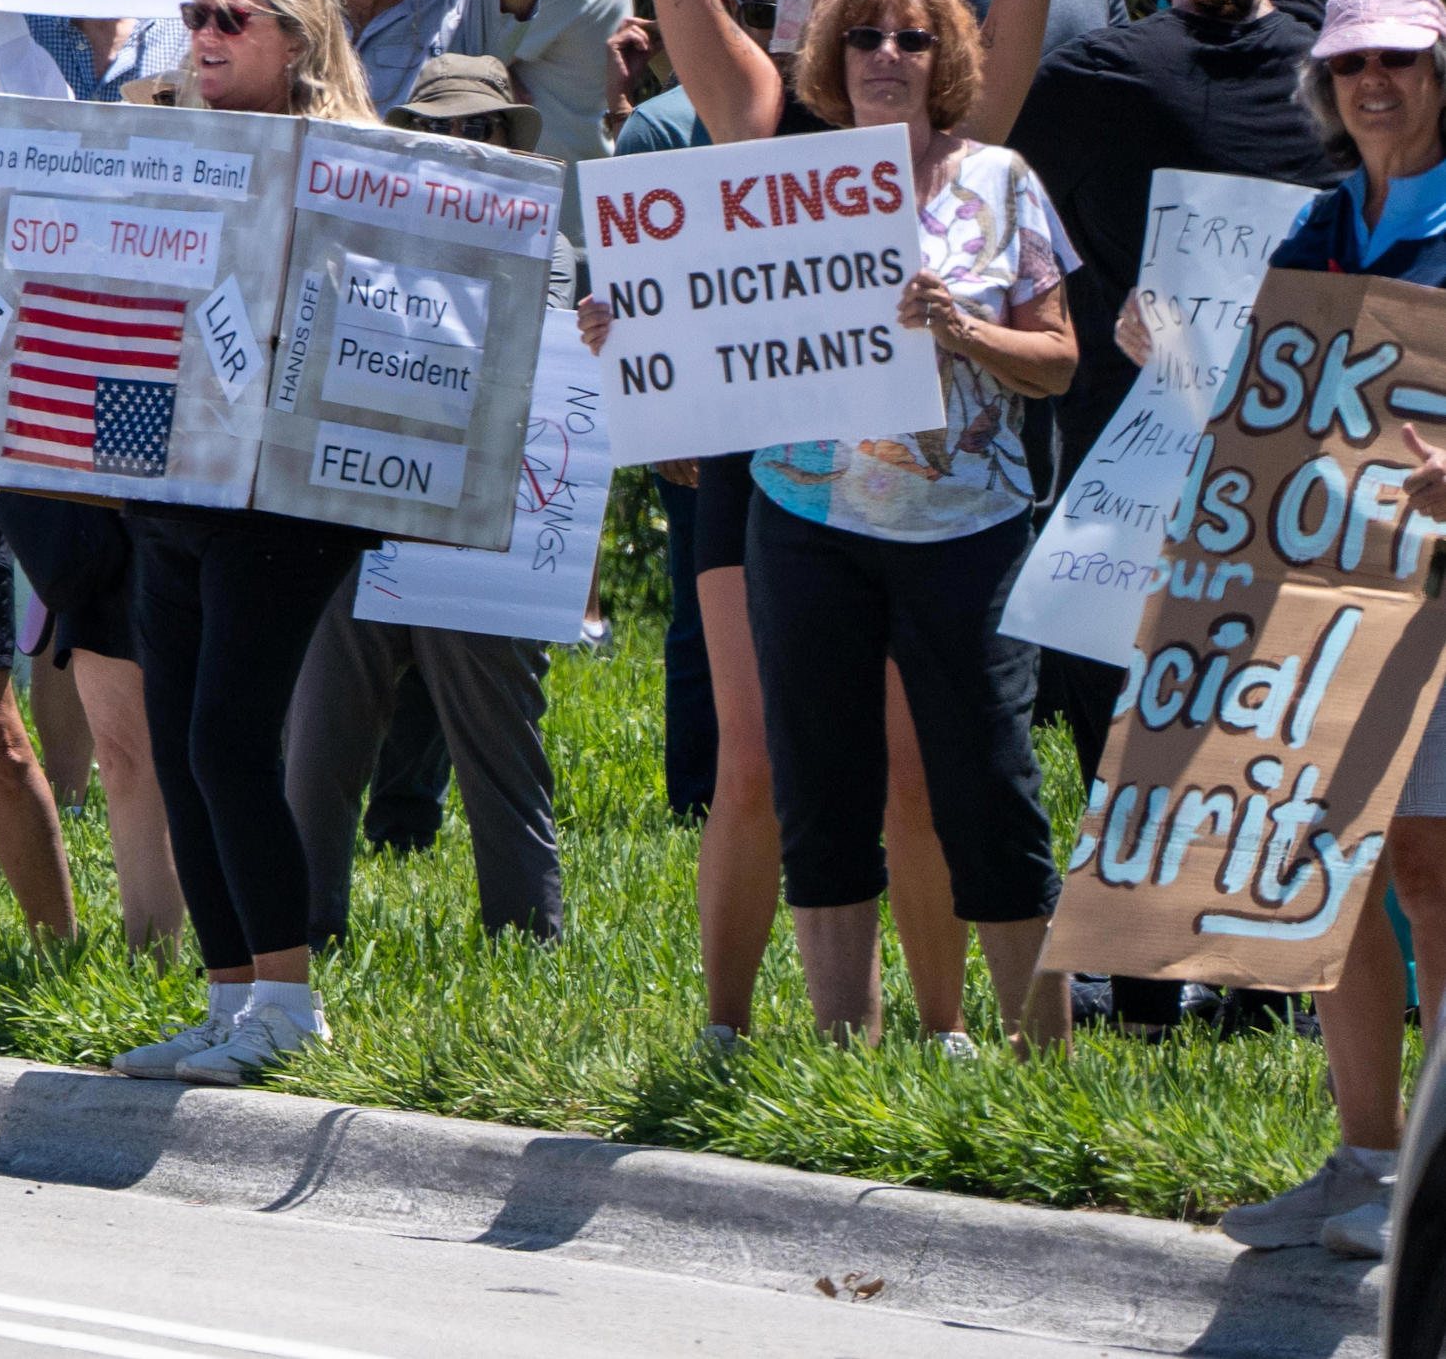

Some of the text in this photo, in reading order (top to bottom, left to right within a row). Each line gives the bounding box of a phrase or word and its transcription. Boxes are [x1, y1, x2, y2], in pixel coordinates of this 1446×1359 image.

[7, 152, 18, 169] a
[24, 147, 126, 178] Republican
[130, 154, 168, 182] with
[172, 163, 183, 182] a
[192, 159, 247, 189] Brain!
[309, 161, 550, 236] DUMP TRUMP!
[596, 160, 903, 248] NO KINGS
[11, 218, 207, 264] STOP TRUMP!
[347, 276, 448, 324] Not my
[610, 248, 904, 319] NO DICTATORS
[205, 295, 248, 384] LIAR
[278, 279, 320, 403] HANDS OFF
[337, 338, 471, 393] President
[619, 325, 894, 396] NO TYRANTS
[565, 385, 600, 434] NO
[320, 445, 433, 495] FELON
